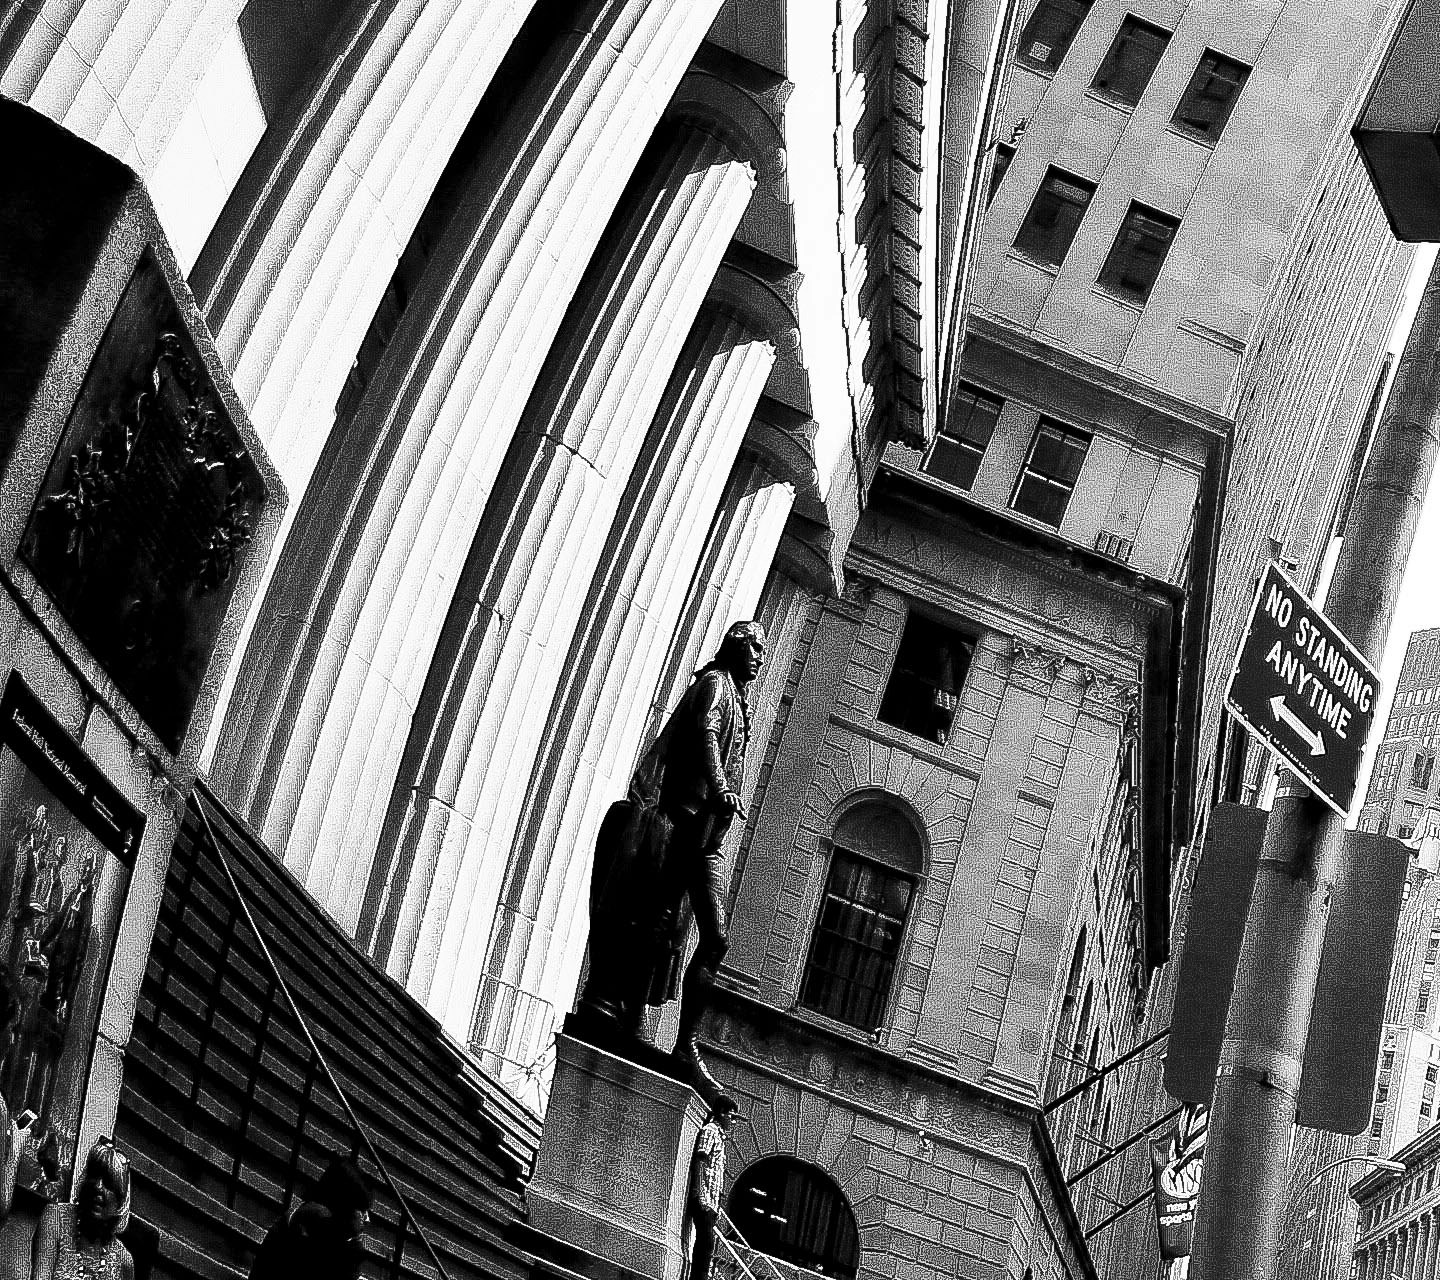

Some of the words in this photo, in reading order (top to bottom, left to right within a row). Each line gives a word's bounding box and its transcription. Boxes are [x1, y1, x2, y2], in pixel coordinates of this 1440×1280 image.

[1264, 640, 1352, 740] ANYTIME
[1265, 583, 1293, 628] NO
[1295, 615, 1373, 713] STANDING
